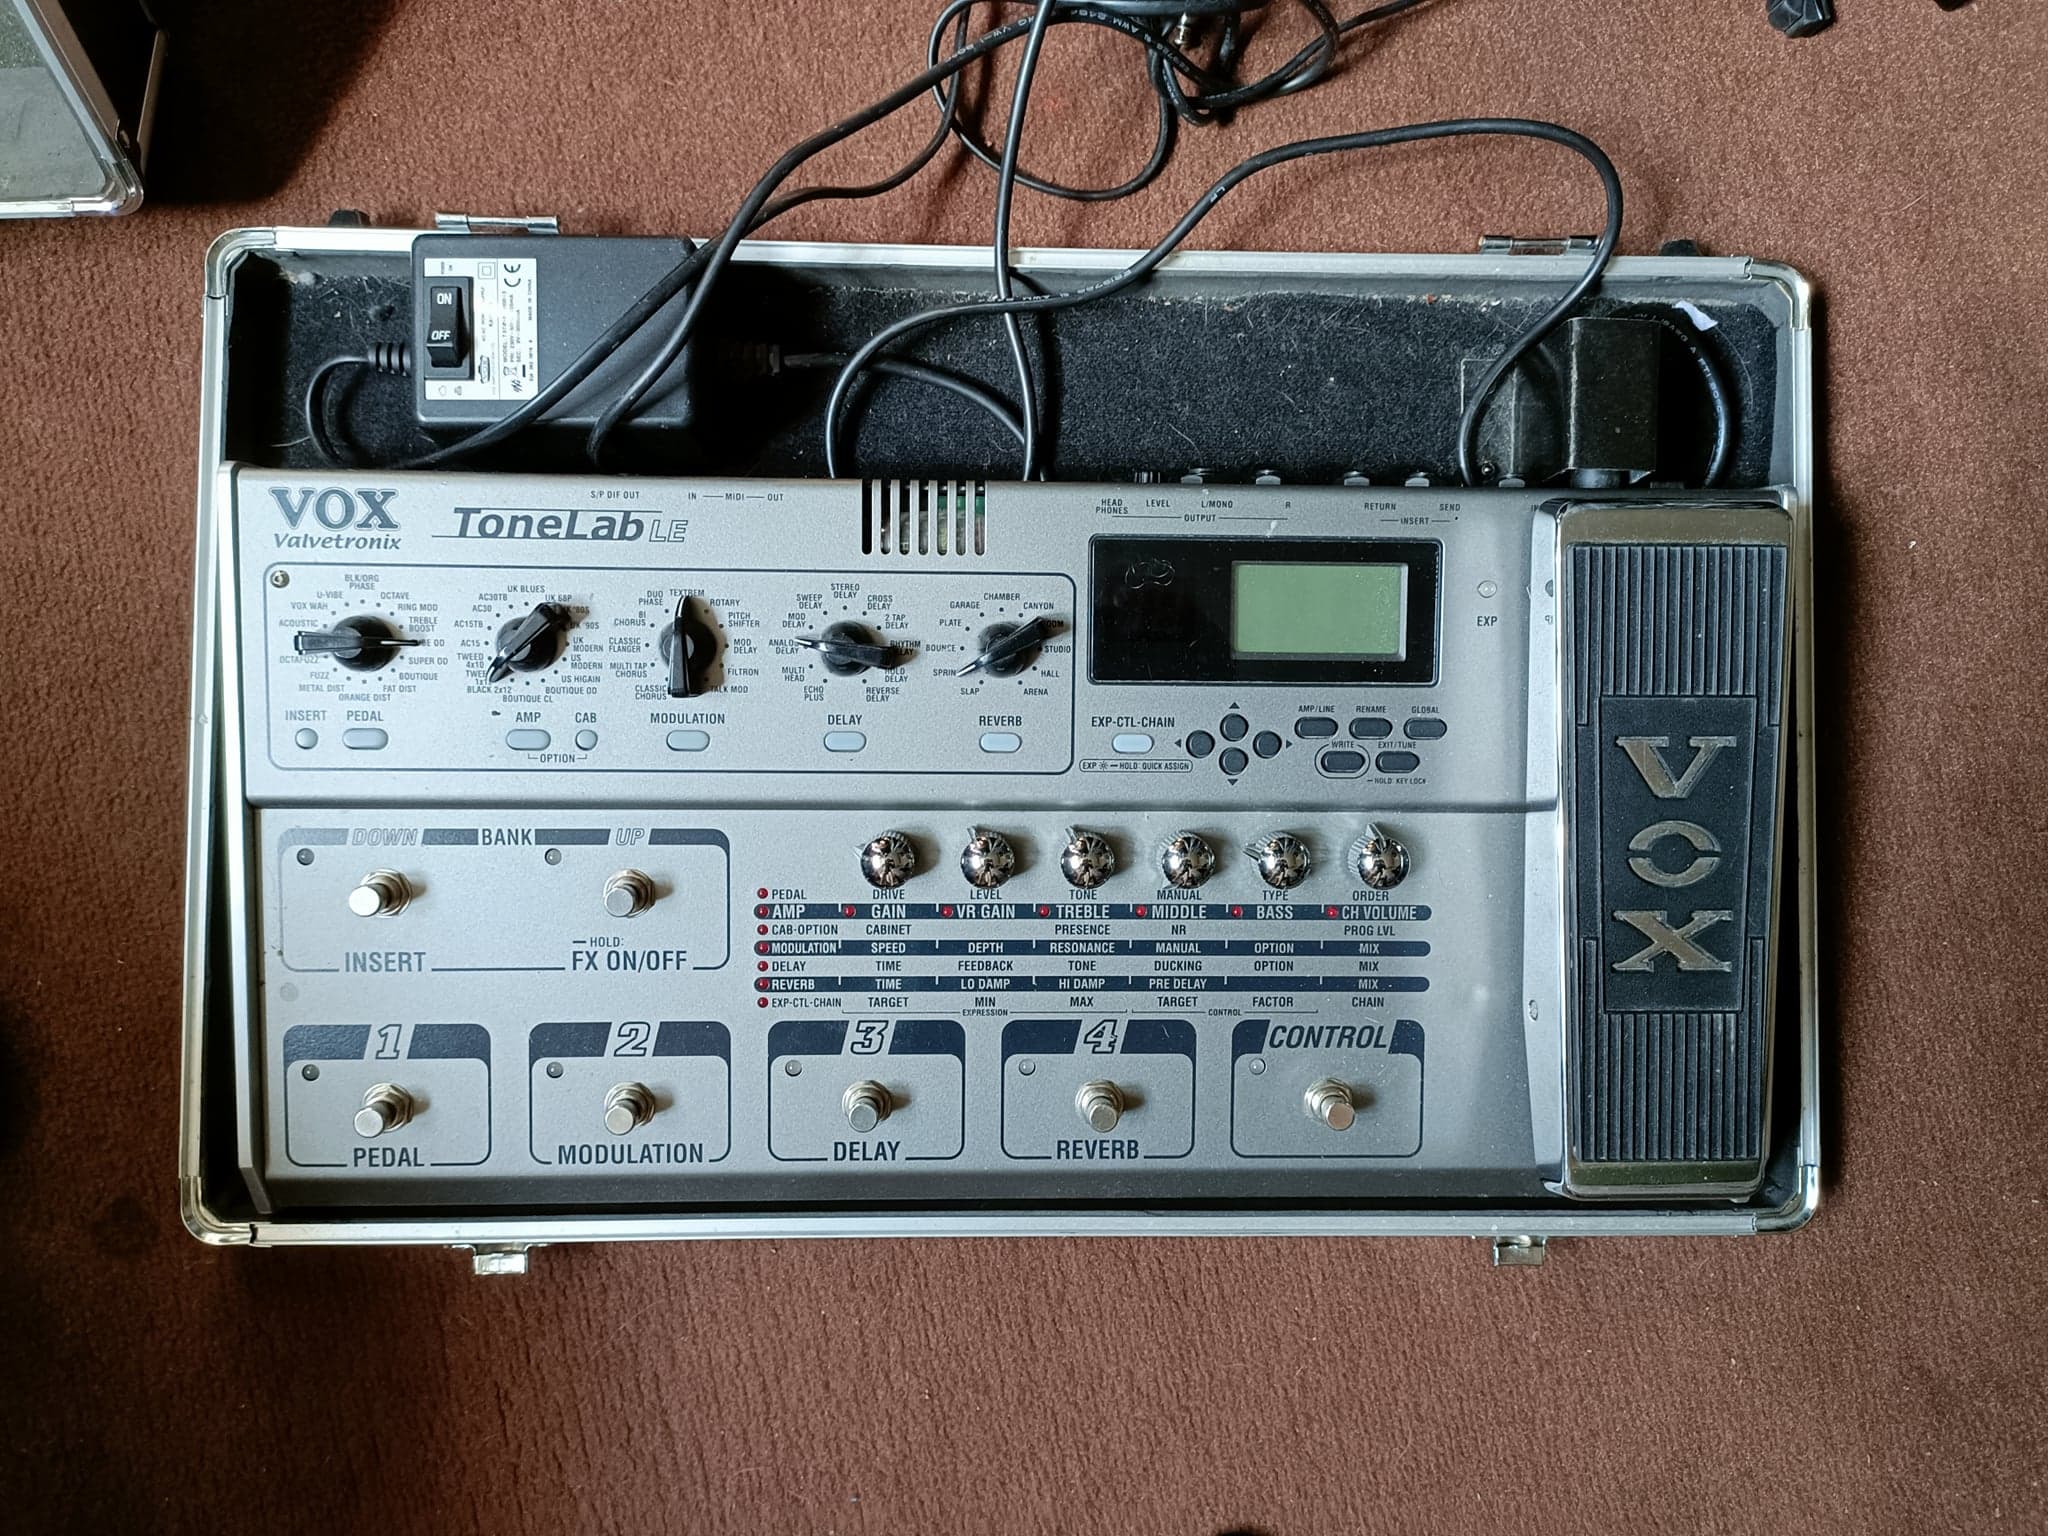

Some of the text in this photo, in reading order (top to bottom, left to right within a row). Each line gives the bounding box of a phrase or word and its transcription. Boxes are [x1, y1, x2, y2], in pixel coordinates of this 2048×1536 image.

[437, 293, 452, 304] ON
[431, 330, 451, 340] OFF
[688, 492, 697, 500] IN
[767, 493, 784, 501] OUT
[269, 487, 401, 530] VOX
[1146, 500, 1171, 508] LEVEL
[1364, 503, 1396, 511] RETURN
[1439, 503, 1461, 511] SEND
[1096, 506, 1129, 514] PHONES
[1184, 514, 1217, 522] OUTPUT
[1401, 517, 1429, 525] INSERT
[454, 507, 688, 542] ToneLab LE
[274, 533, 401, 550] Valvetronix
[344, 574, 380, 582] BLK/ORG
[350, 582, 375, 590] PHASE
[520, 585, 545, 593] BLUES
[831, 583, 860, 591] STEREO
[380, 592, 409, 600] OCTAVE
[799, 601, 823, 609] DELAY
[868, 602, 891, 610] DELAY
[950, 601, 980, 609] GARAGE
[1023, 602, 1054, 610] CANYON
[729, 612, 750, 620] PITCH
[788, 612, 805, 620] MOD
[729, 620, 760, 628] SHIFTER
[782, 620, 806, 628] DELAY
[885, 621, 909, 629] DELAY
[1476, 616, 1498, 627] EXP
[609, 637, 641, 645] CLASSIC
[609, 645, 641, 653] FLANGER
[775, 647, 799, 655] DELAY
[615, 670, 648, 678] CHORUS
[782, 666, 805, 674] MULTI
[933, 669, 960, 677] SPRIN
[785, 674, 805, 682] HEAD
[885, 675, 908, 683] DELAY
[866, 687, 900, 695] REVERSE
[1024, 688, 1048, 696] ARENA
[804, 693, 824, 701] PLUS
[285, 711, 327, 721] INSERT
[347, 711, 384, 721] PEDAL
[515, 712, 541, 722] AMP
[575, 712, 597, 723] CAB
[650, 713, 725, 724] MODULATION
[827, 715, 862, 725] DELAY
[979, 715, 1022, 726] REVERB
[1092, 717, 1175, 728] EXP-CTL-CHAIN
[540, 754, 575, 763] OPTION
[351, 828, 418, 846] DOWN
[482, 828, 533, 846] BANK
[615, 828, 646, 846] UP
[1612, 735, 1737, 973] VOX
[771, 889, 807, 900] PEDAL
[873, 889, 905, 900] DRIVE
[970, 889, 1002, 900] LEVEL
[1070, 889, 1097, 900] TONE
[1156, 890, 1202, 900] MANUAL
[1263, 890, 1288, 901] TYPE
[1353, 891, 1389, 901] ORDER
[772, 905, 805, 918] AMP
[871, 905, 906, 918] GAIN
[957, 905, 1015, 918] VR GAIN
[1056, 905, 1110, 918] TREBLE
[1152, 905, 1207, 919] MIDDLE
[1256, 905, 1293, 919] BASS
[1342, 905, 1416, 920] CH VOLUME
[771, 924, 838, 935] CAB-OPTION
[866, 924, 912, 935] CABINET
[1055, 924, 1110, 935] PRESENCE
[1171, 925, 1186, 934] NR
[1344, 925, 1395, 936] PROG LVL
[590, 936, 625, 947] HOLD:
[771, 943, 837, 953] MODULATION
[871, 943, 906, 953] SPEED
[968, 942, 1003, 953] DEPTH
[1050, 942, 1115, 953] RESONANCE
[1155, 943, 1202, 953] MANUAL
[1254, 943, 1294, 953] OPTION
[1359, 943, 1380, 954] MIX
[344, 952, 426, 973] INSERT
[572, 950, 688, 973] FX ON/OFF
[772, 961, 806, 971] DELAY
[876, 961, 902, 971] TIME
[958, 961, 1013, 971] FEEDBACK
[1068, 961, 1096, 971] TONE
[1154, 961, 1202, 971] DUCKING
[1254, 961, 1294, 971] OPTION
[1359, 961, 1379, 971] MIX
[771, 979, 815, 990] REVERB
[875, 979, 902, 989] TIME
[961, 979, 1010, 989] LO DAMP
[1059, 979, 1105, 989] HI DAMP
[1150, 979, 1207, 989] PRE DELAY
[1358, 979, 1379, 989] MIX
[771, 997, 841, 1007] EXP-CTL-CHAIN
[868, 997, 909, 1007] TARGET
[975, 997, 996, 1007] MIN
[1070, 997, 1093, 1007] MAX
[1158, 997, 1198, 1007] TARGET
[1253, 996, 1293, 1007] FACTOR
[1352, 997, 1384, 1007] CHAIN
[375, 1024, 403, 1059] 1
[614, 1022, 650, 1057] 2
[849, 1021, 886, 1054] 3
[1082, 1020, 1120, 1054] 4
[1268, 1024, 1388, 1050] CONTROL
[558, 1143, 704, 1165] MODULATION
[833, 1140, 901, 1162] DELAY
[1056, 1139, 1139, 1161] REVERB
[353, 1148, 425, 1168] PEDAL
